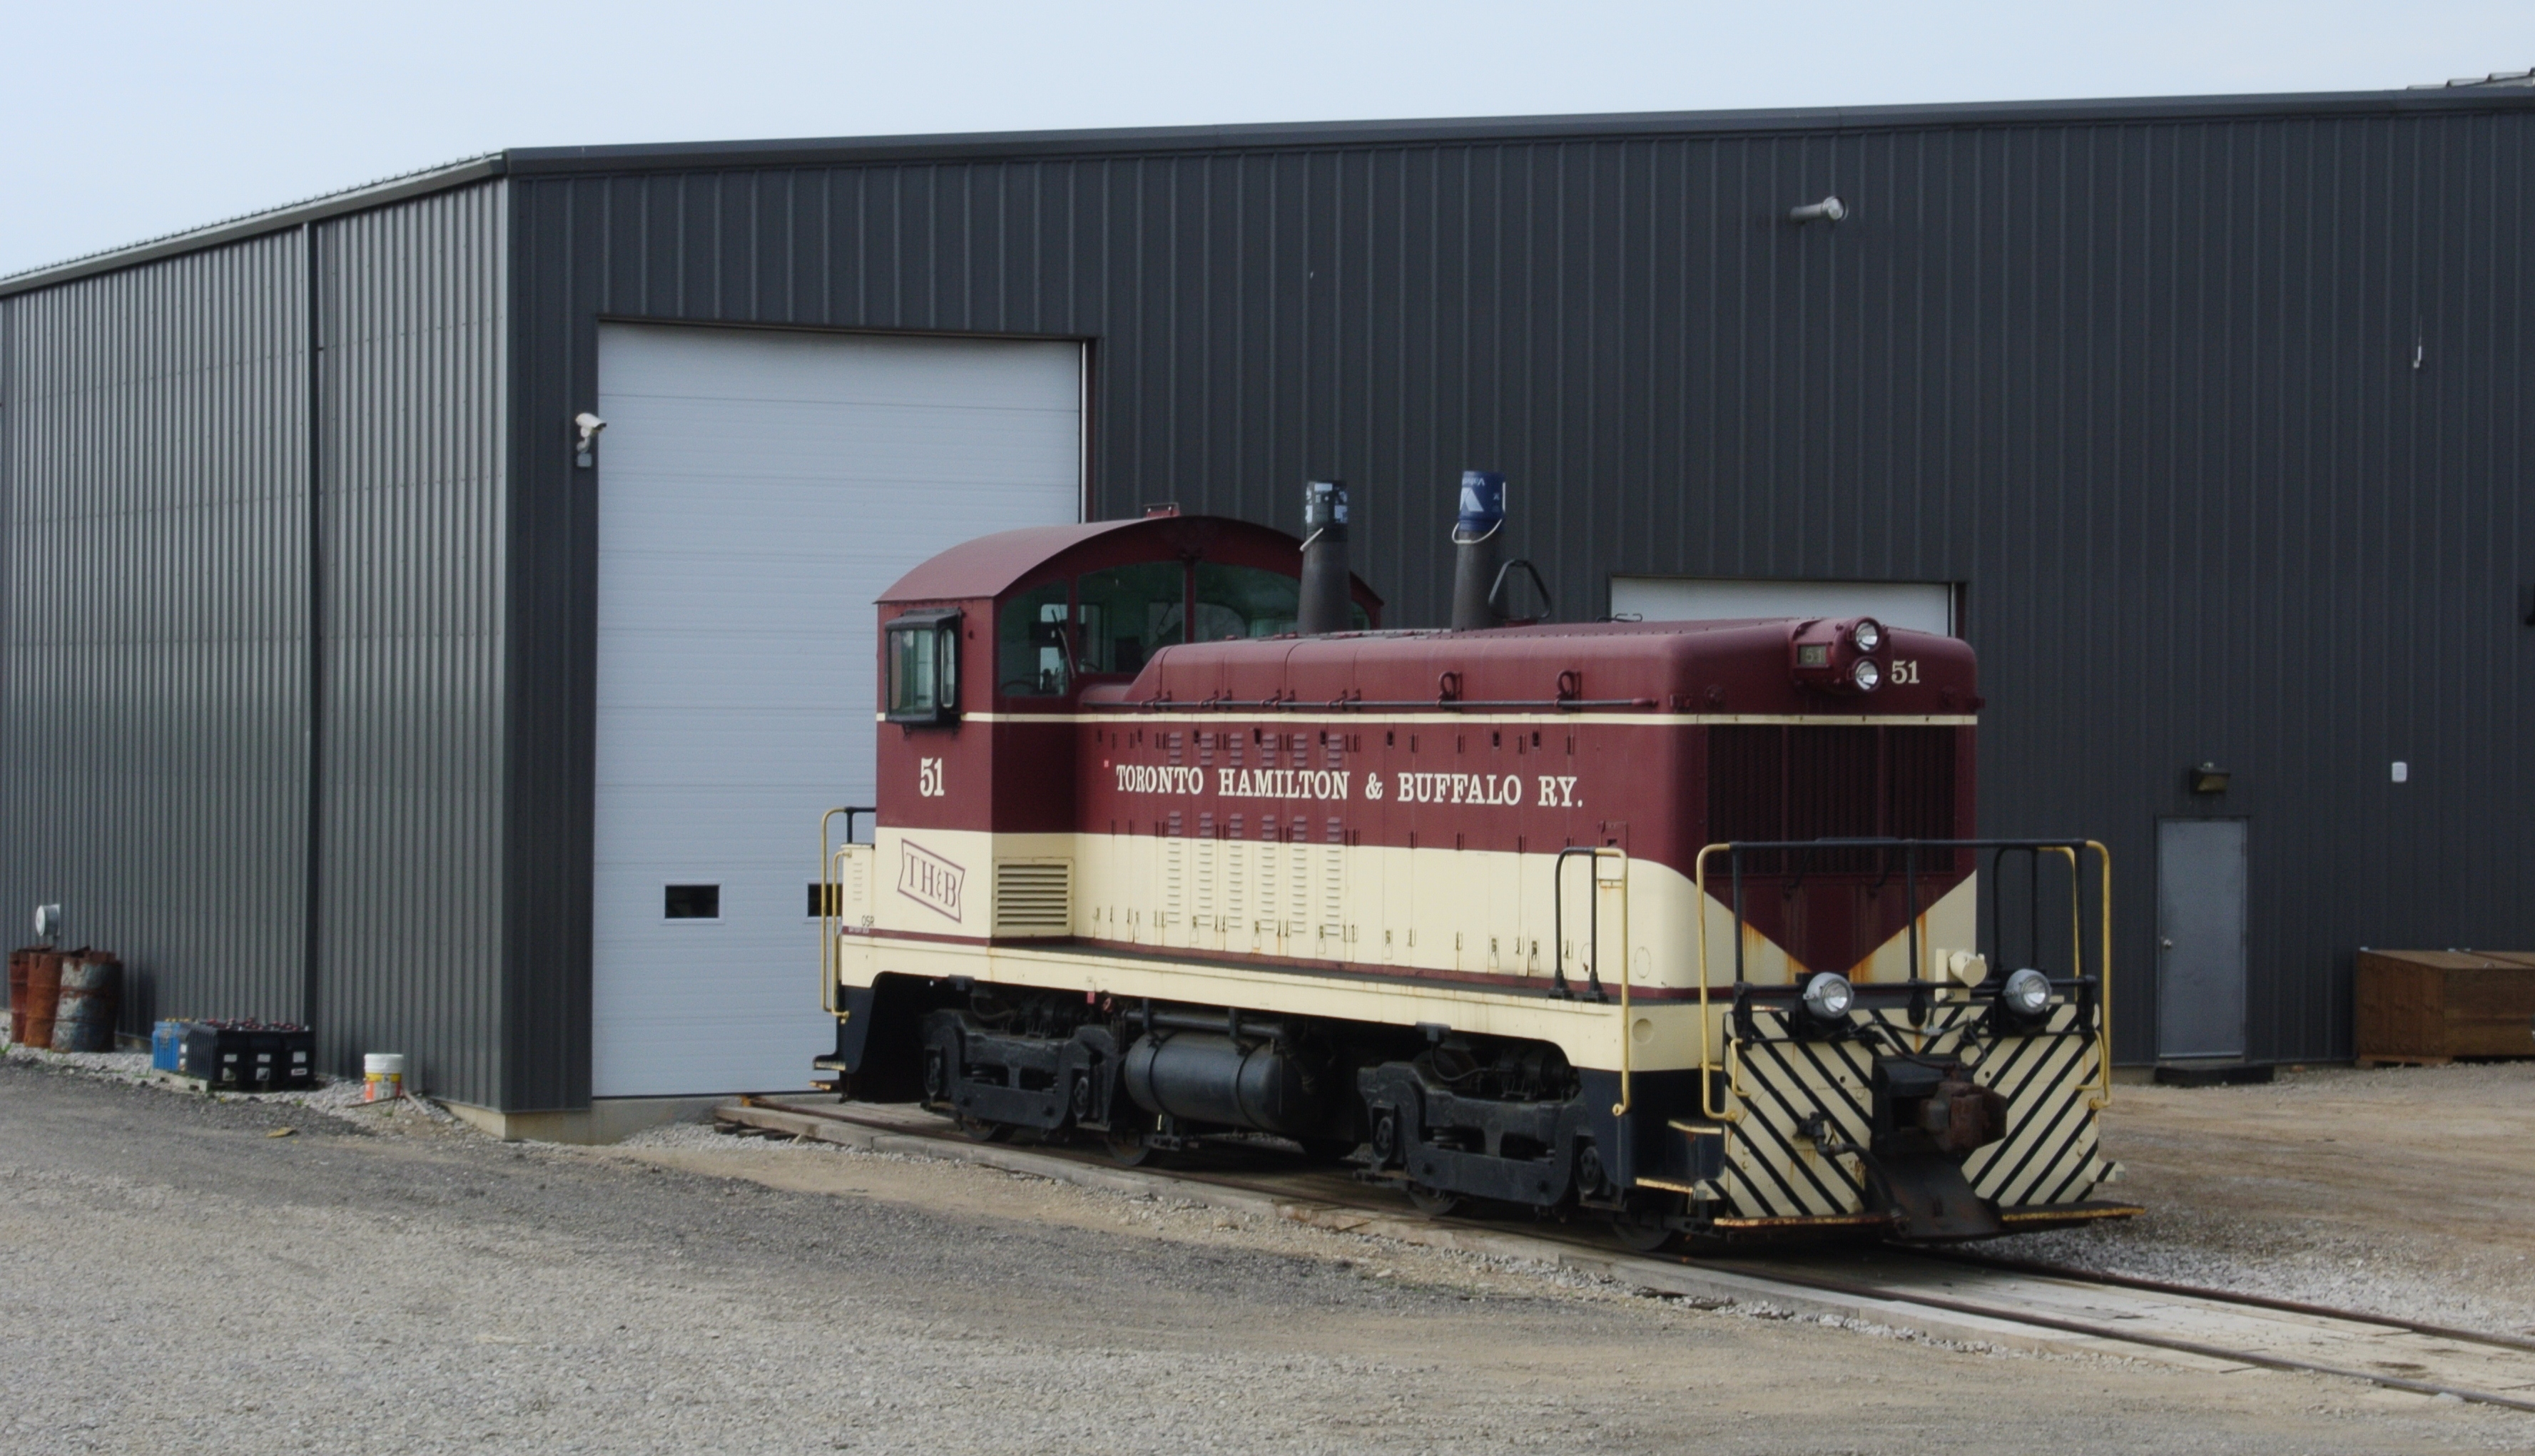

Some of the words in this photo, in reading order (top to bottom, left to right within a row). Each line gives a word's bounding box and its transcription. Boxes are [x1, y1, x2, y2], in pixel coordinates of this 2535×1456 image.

[1891, 661, 1920, 683] 51
[920, 757, 945, 798] 51
[1116, 764, 1204, 795] TORONTO
[1218, 768, 1351, 800] HAMILTON
[1365, 771, 1383, 800] &
[1397, 772, 1523, 806] BUFFALO
[1538, 775, 1583, 808] RY.
[905, 852, 957, 909] TH&B
